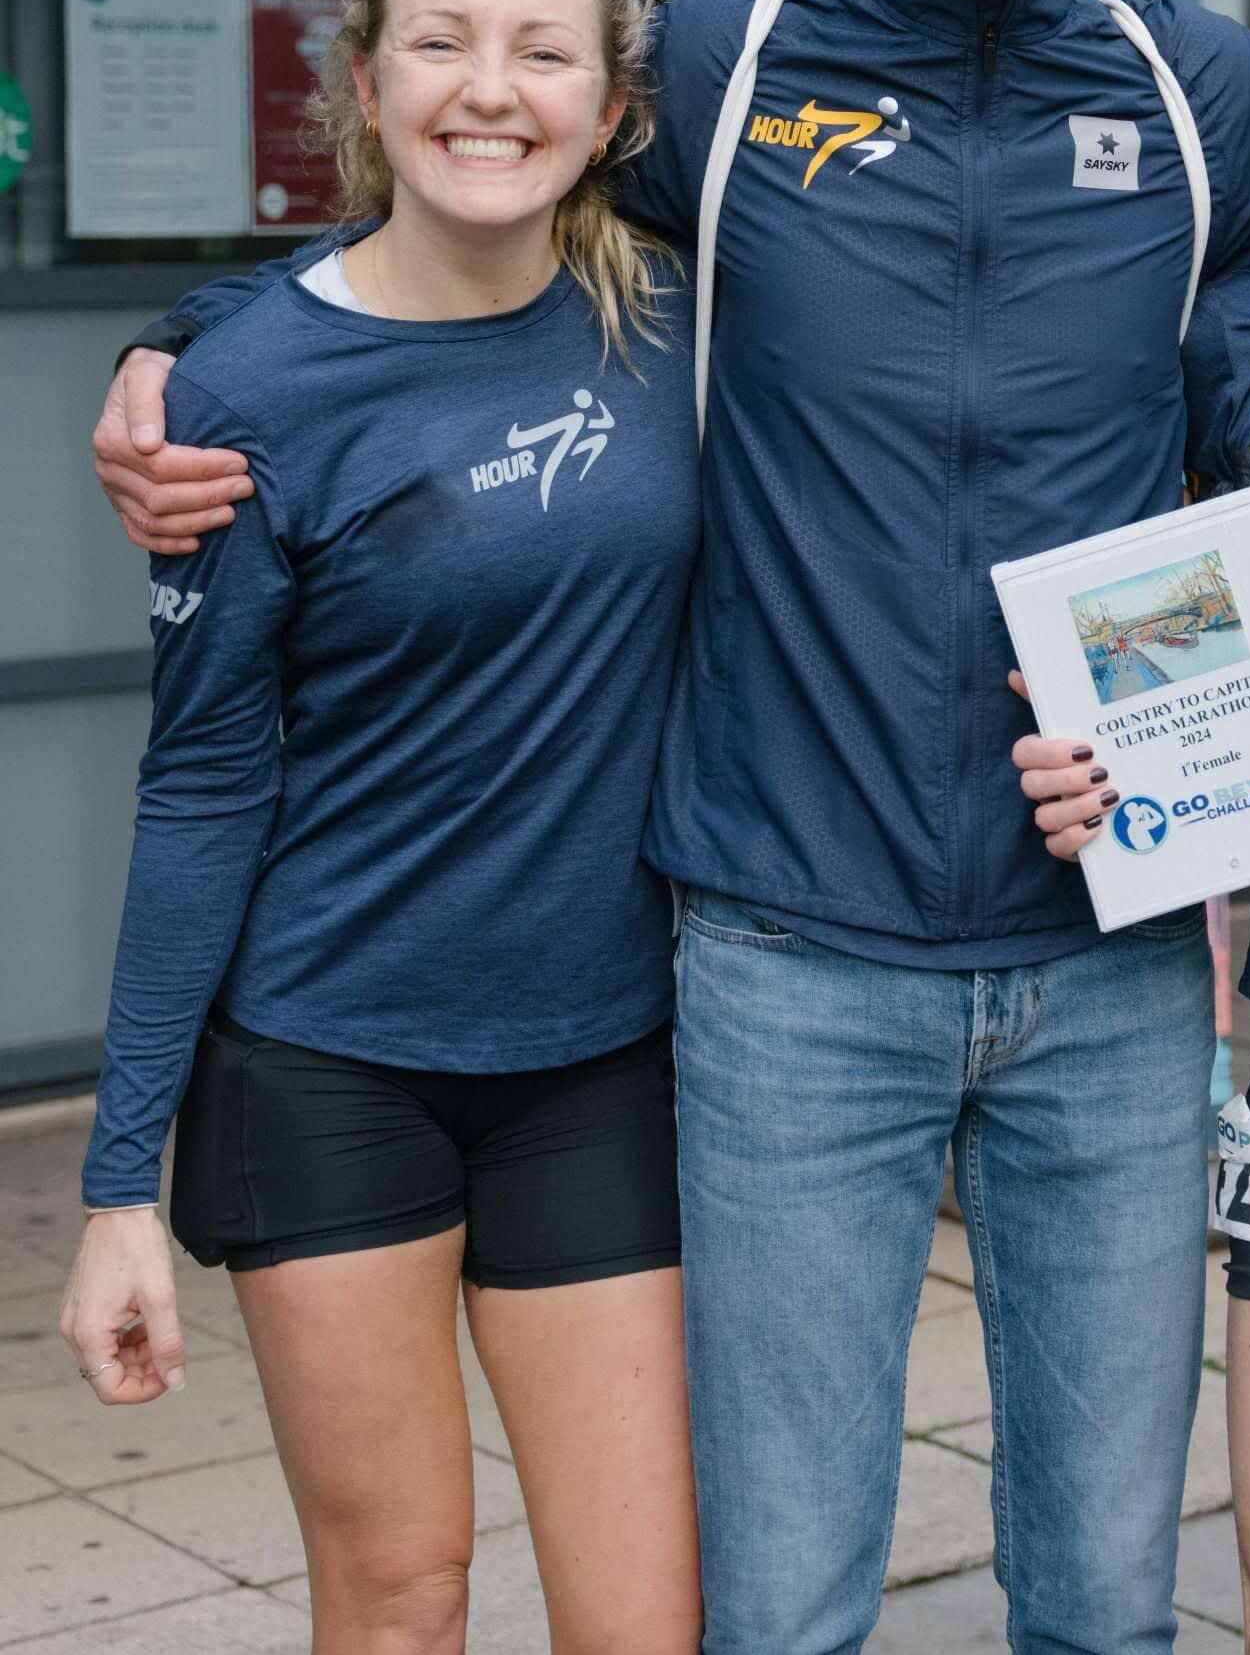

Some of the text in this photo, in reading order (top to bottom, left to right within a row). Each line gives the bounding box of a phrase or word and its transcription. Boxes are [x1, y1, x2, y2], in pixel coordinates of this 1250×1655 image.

[748, 115, 819, 149] HOUR
[1083, 158, 1130, 173] SAYSKY
[470, 450, 538, 493] HOUR
[1095, 701, 1174, 736] COUNTRY
[1176, 694, 1200, 710] TO
[1115, 724, 1169, 749] ULTRA
[1179, 728, 1212, 748] 2024
[1193, 750, 1242, 774] Female
[1172, 794, 1209, 817] GO
[1217, 1116, 1236, 1143] GO
